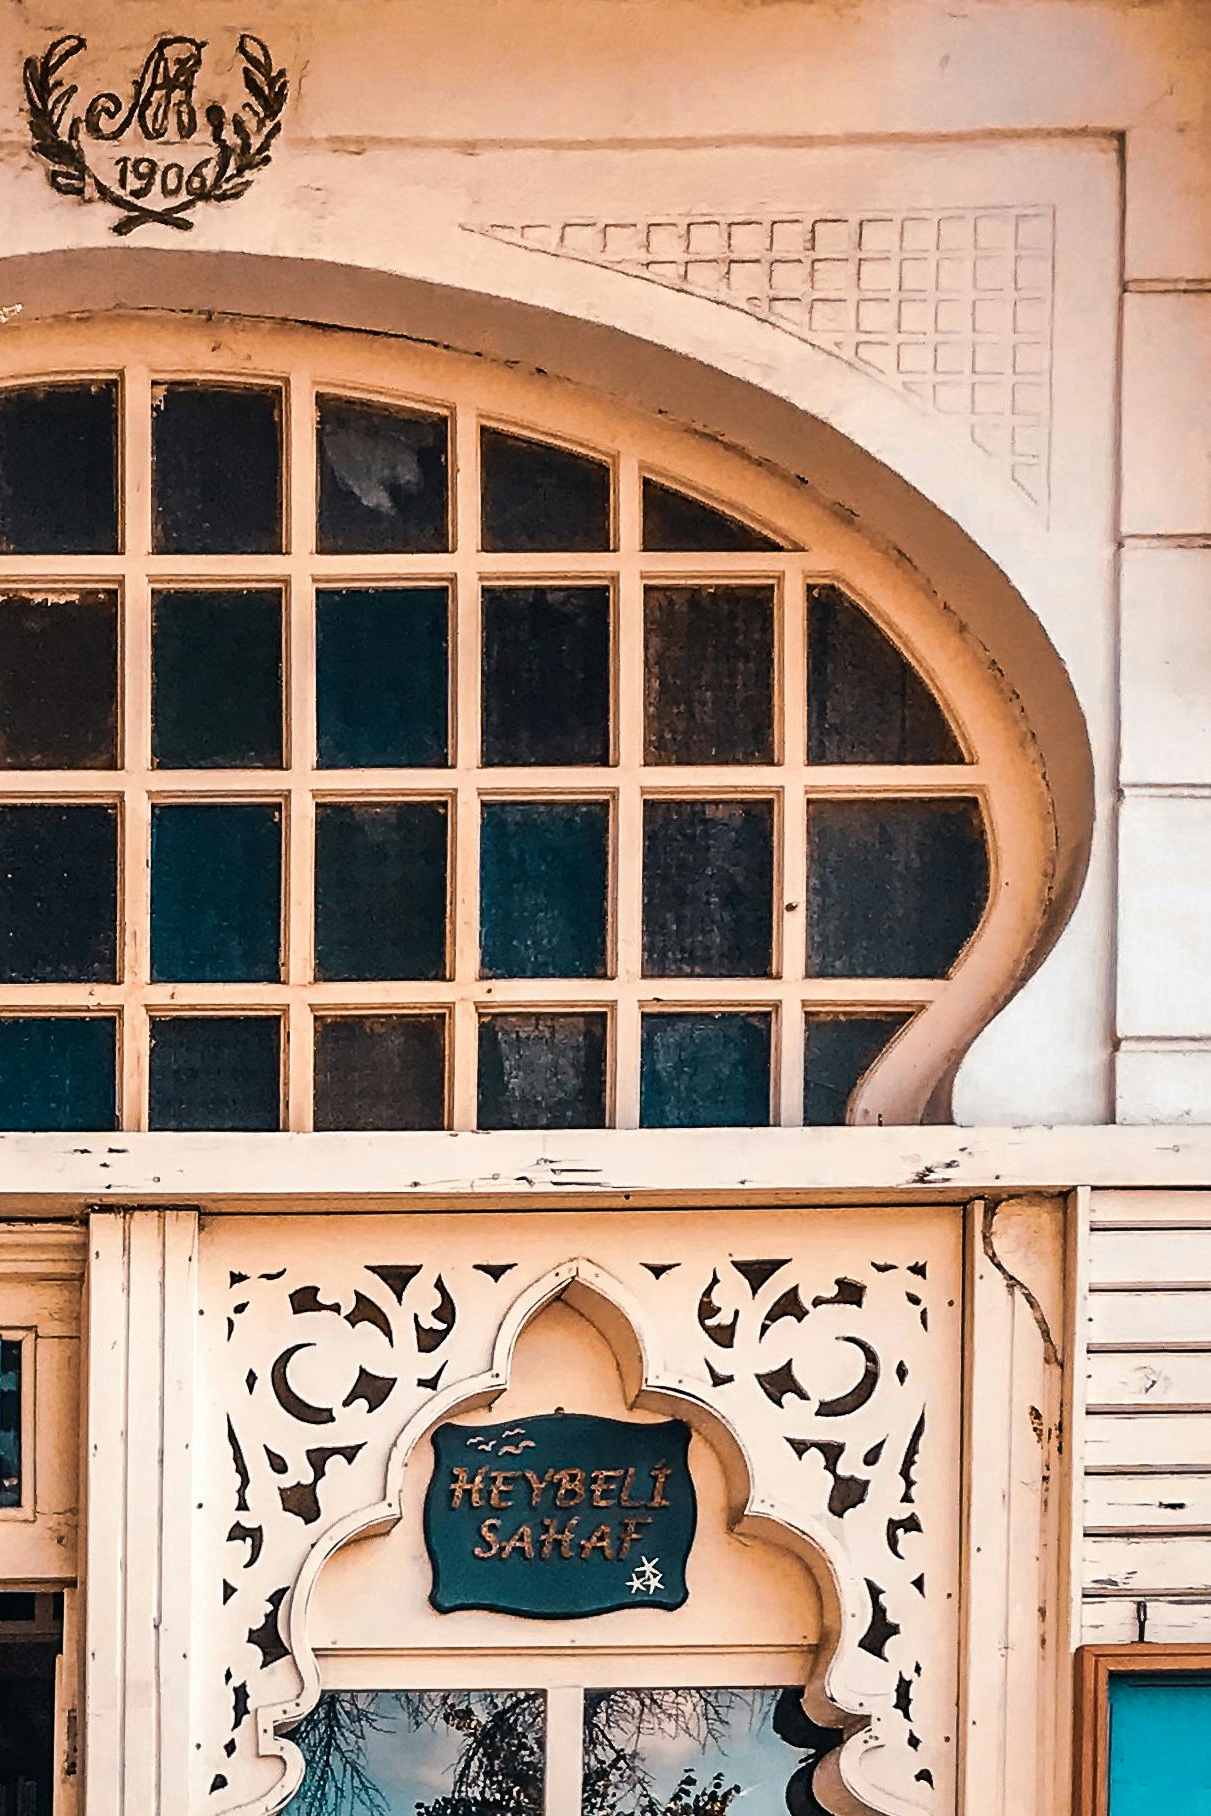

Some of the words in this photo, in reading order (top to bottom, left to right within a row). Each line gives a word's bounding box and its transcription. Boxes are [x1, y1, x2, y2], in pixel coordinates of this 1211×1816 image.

[115, 157, 214, 198] 1906
[449, 1459, 671, 1508] HEYBELİ
[473, 1515, 654, 1559] SAHAF
